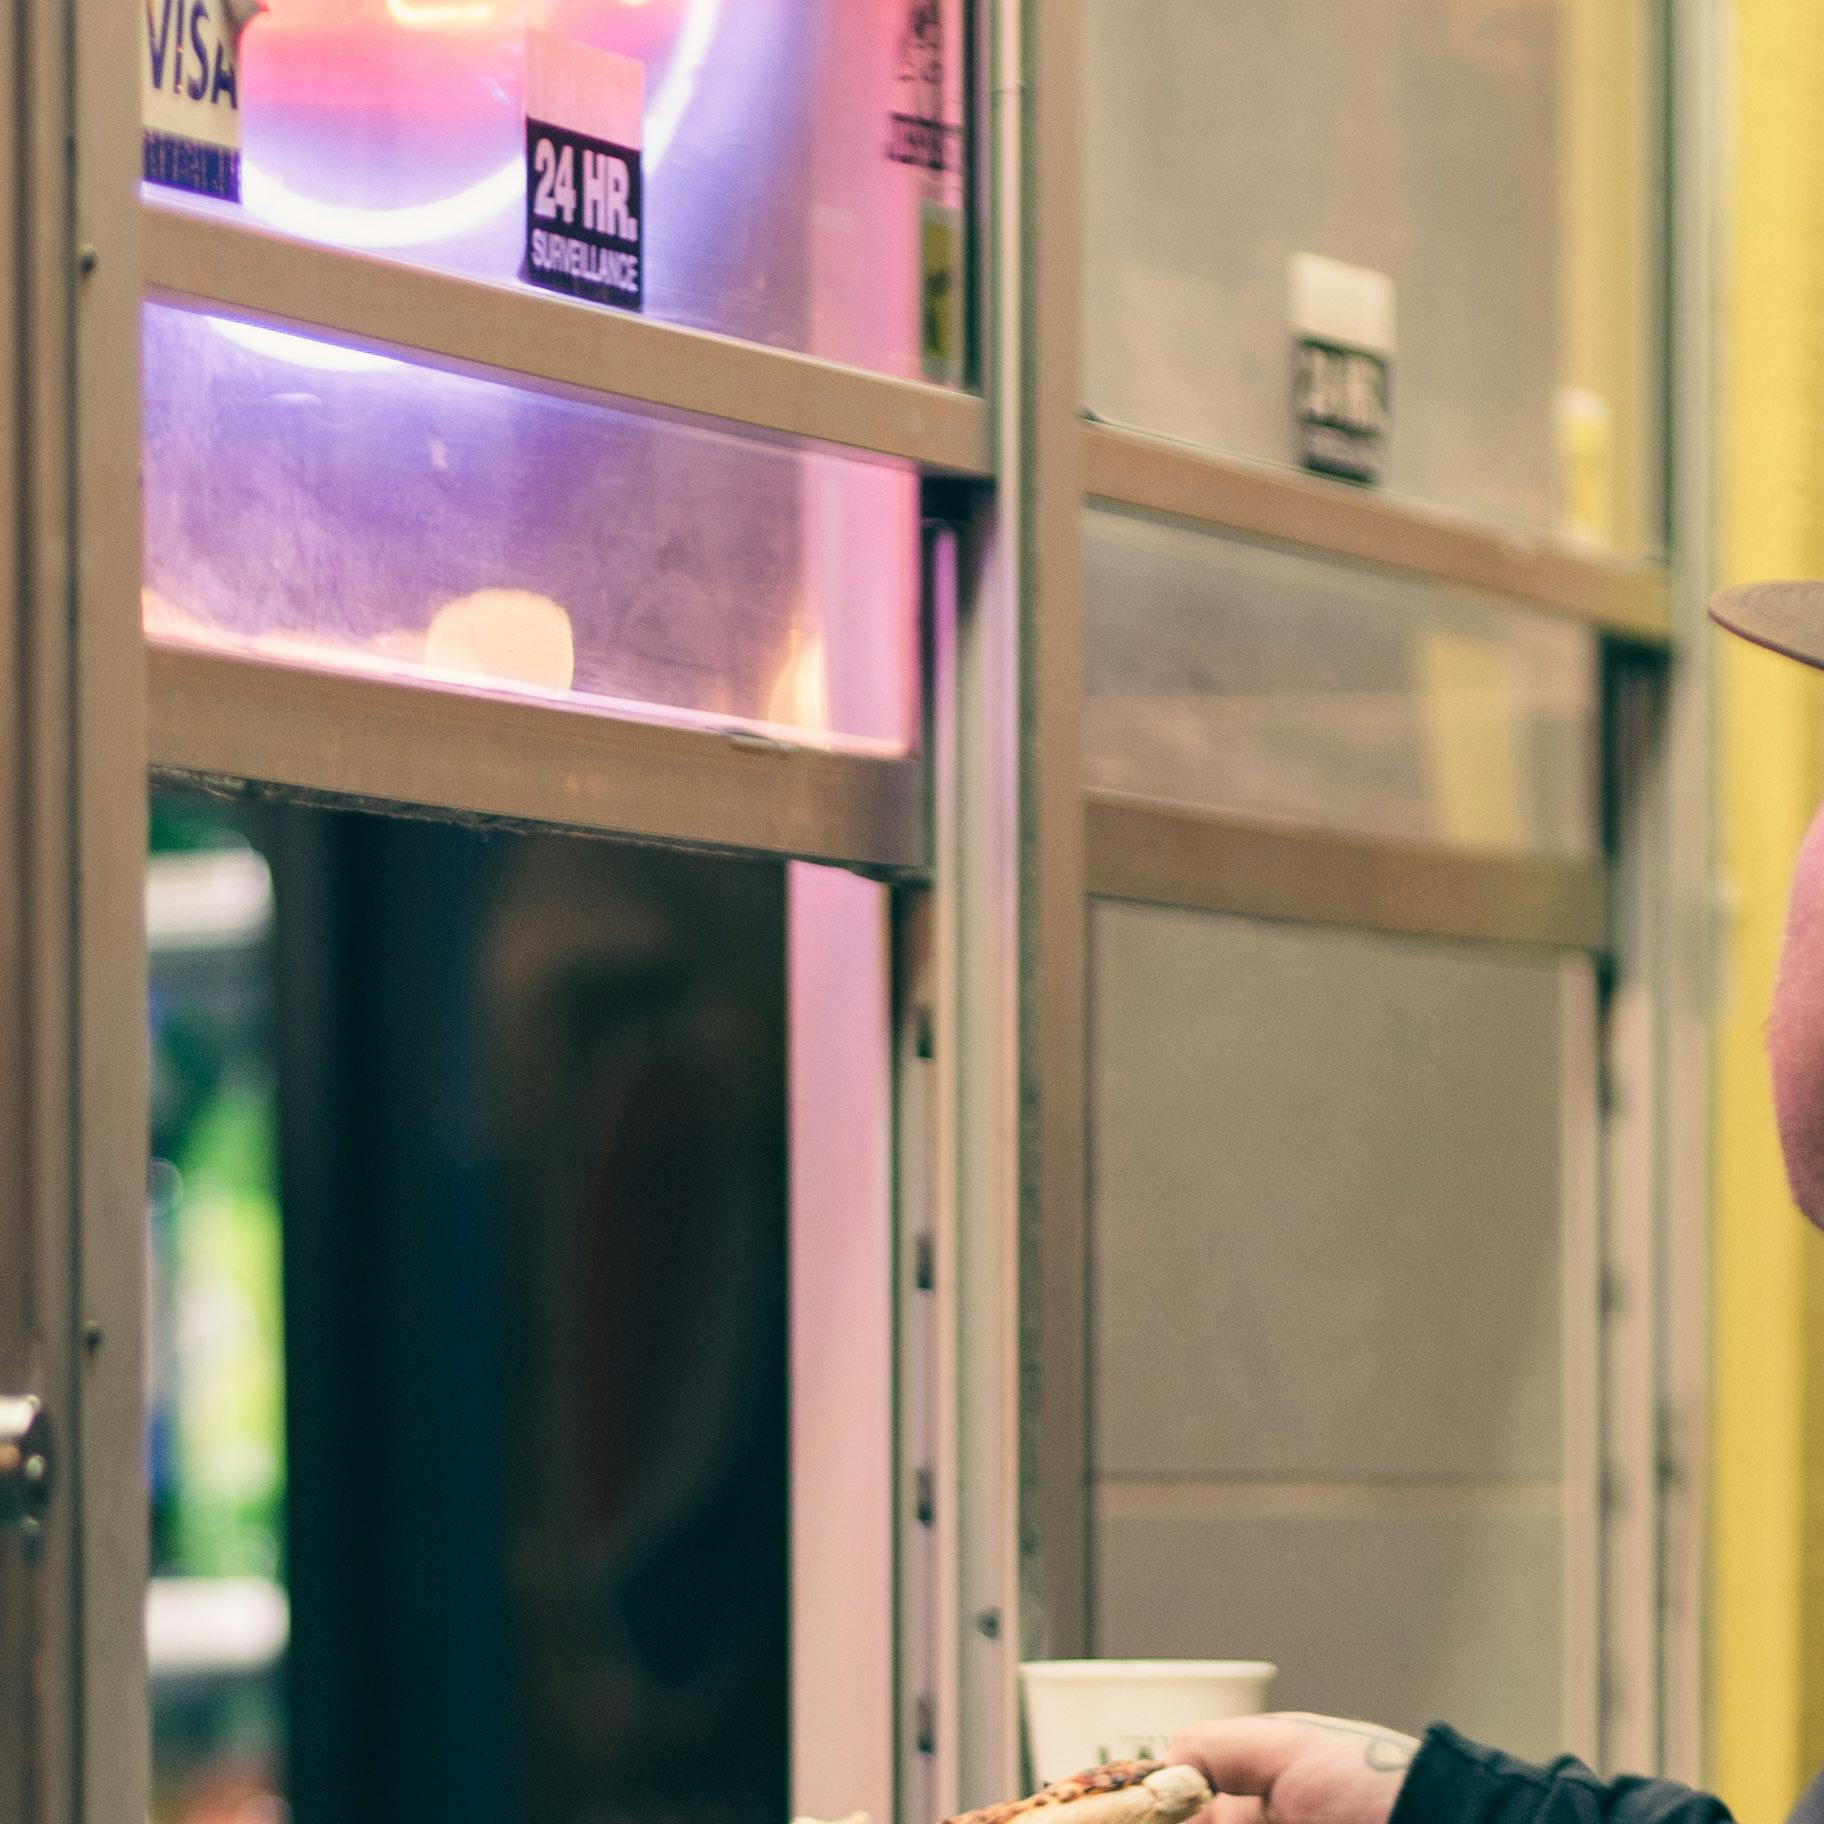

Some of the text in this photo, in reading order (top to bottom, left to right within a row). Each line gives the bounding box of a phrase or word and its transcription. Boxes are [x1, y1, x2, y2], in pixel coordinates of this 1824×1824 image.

[146, 0, 239, 110] VISA
[533, 136, 639, 242] 24 HR.
[531, 227, 639, 293] SURVEILLANCE
